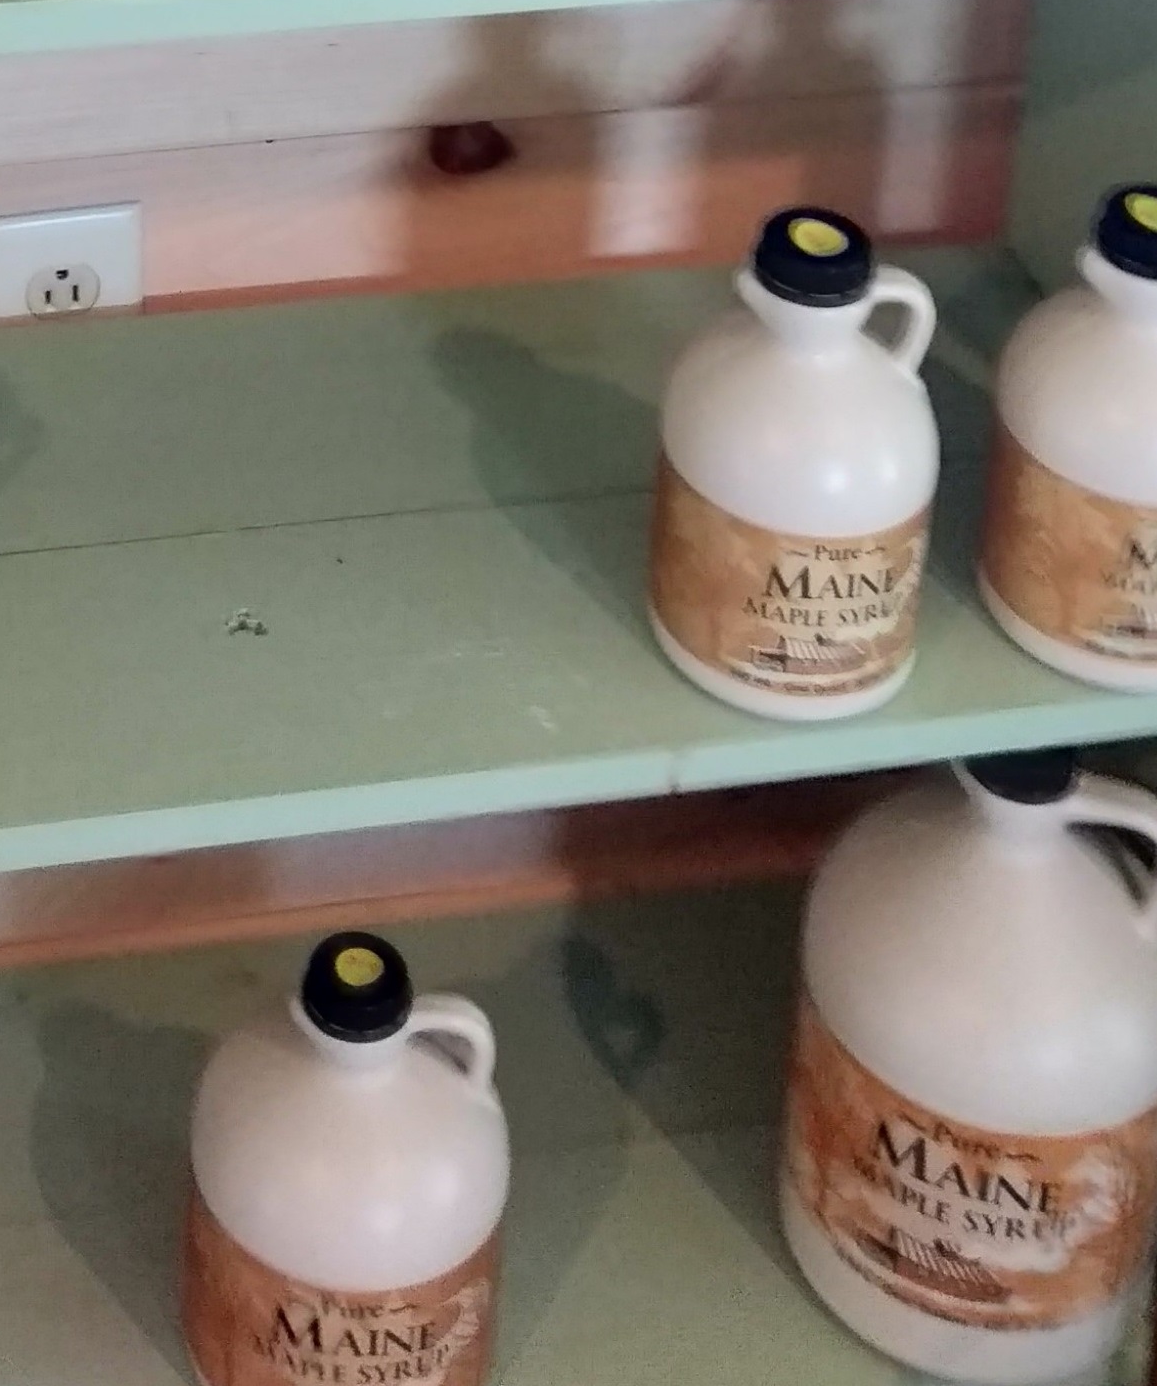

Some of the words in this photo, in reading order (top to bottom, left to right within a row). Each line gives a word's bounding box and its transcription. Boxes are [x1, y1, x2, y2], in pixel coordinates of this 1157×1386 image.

[743, 597, 826, 627] MAPLE
[869, 1120, 1064, 1214] MAINE
[271, 1301, 437, 1355] MAINE
